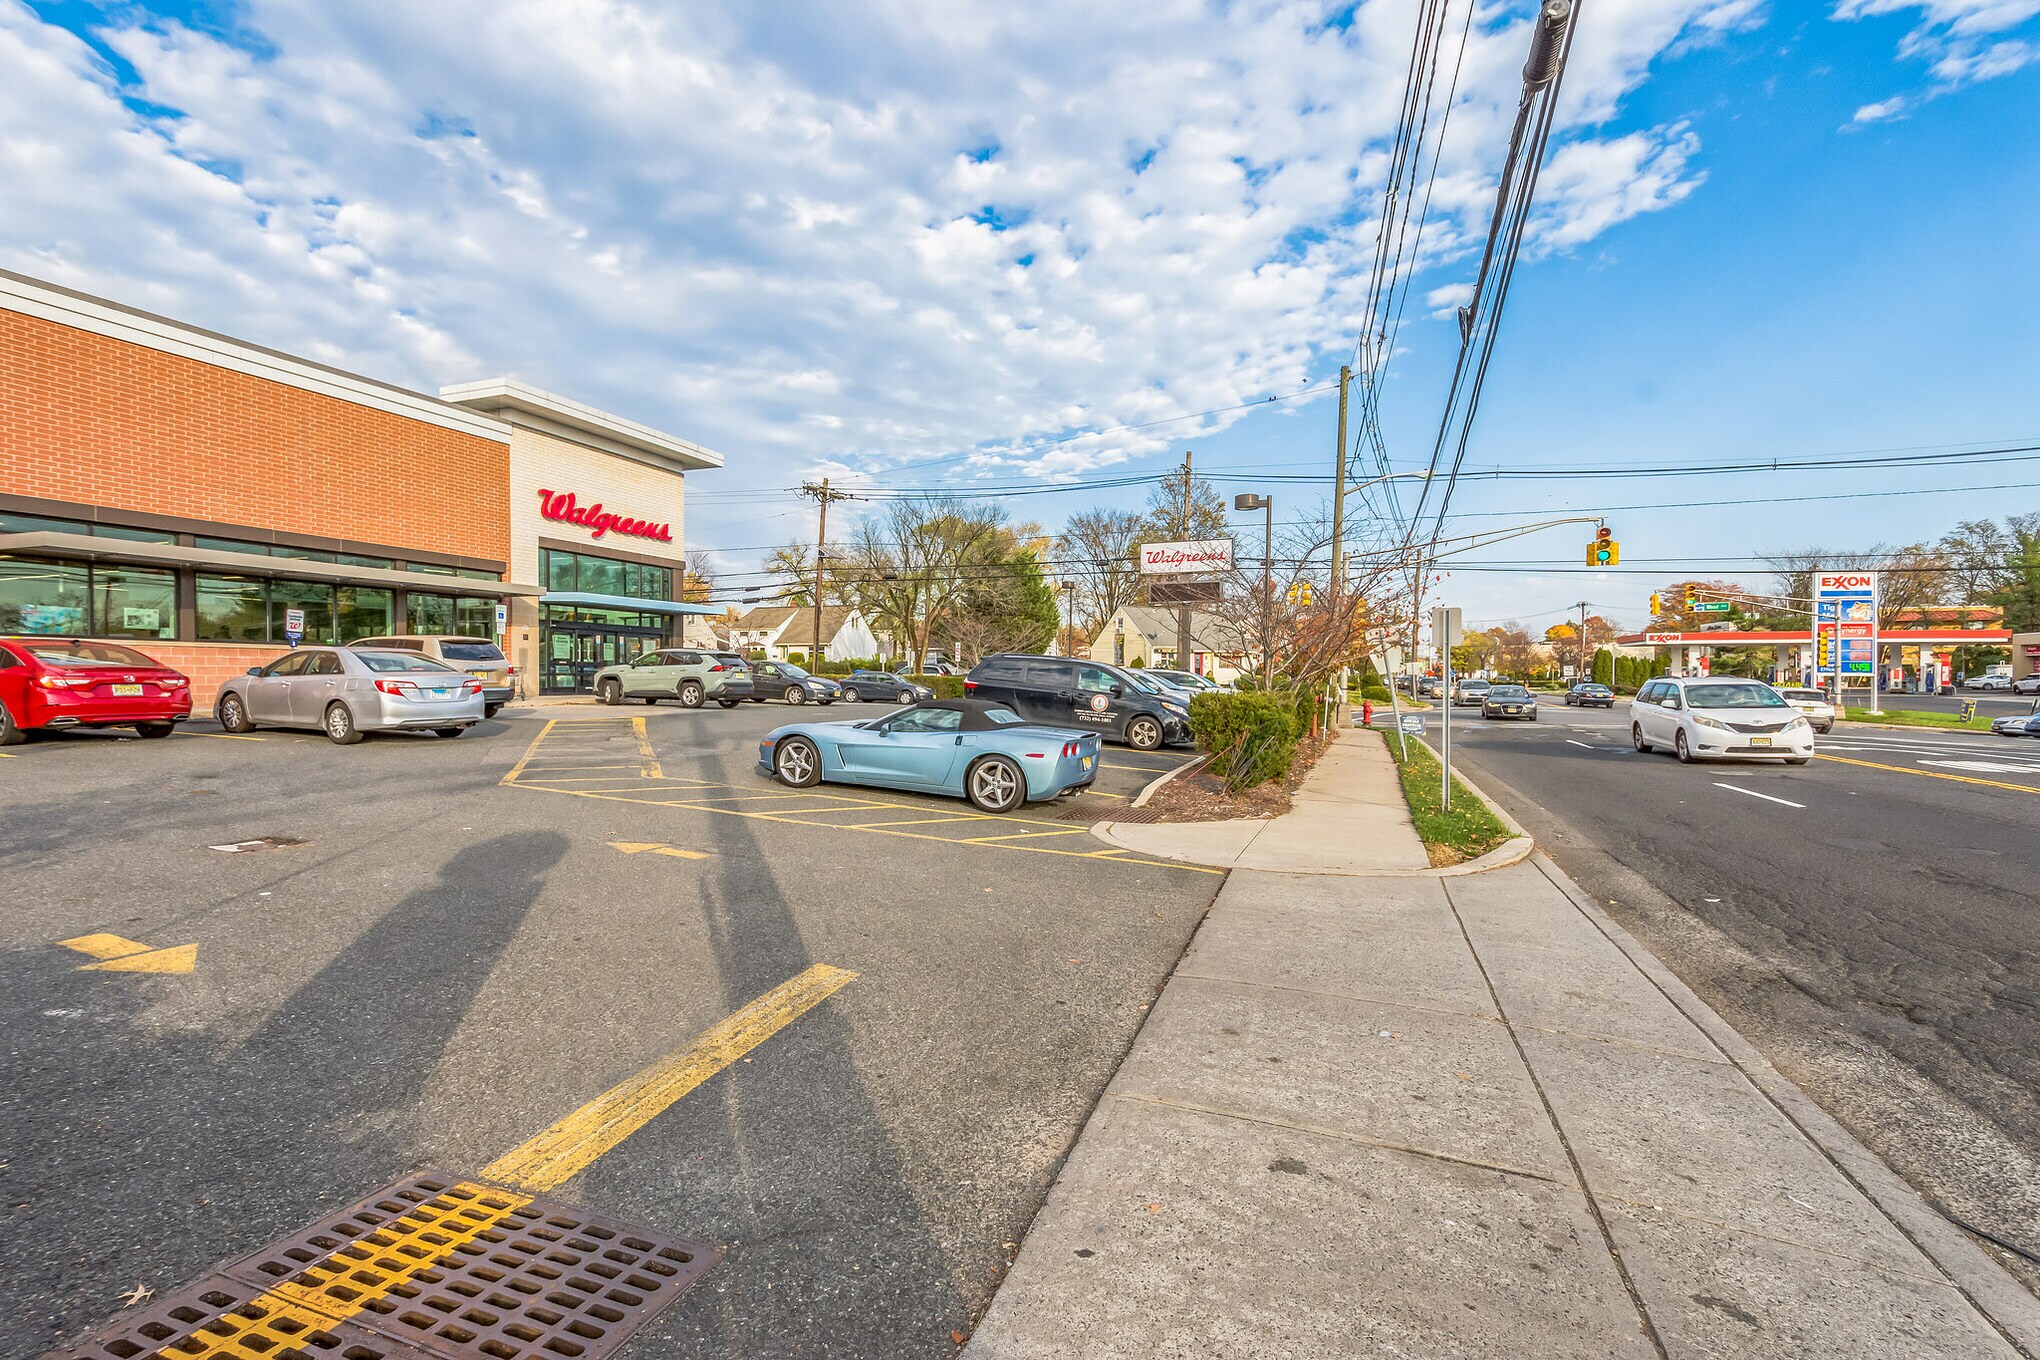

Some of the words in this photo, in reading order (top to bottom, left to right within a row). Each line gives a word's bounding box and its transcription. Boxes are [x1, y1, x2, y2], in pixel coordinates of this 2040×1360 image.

[537, 488, 673, 542] Walgreens
[1146, 549, 1227, 568] Walgreens
[1821, 575, 1871, 590] EXXON
[1649, 633, 1680, 643] EXXON
[1841, 628, 1867, 636] ynergy
